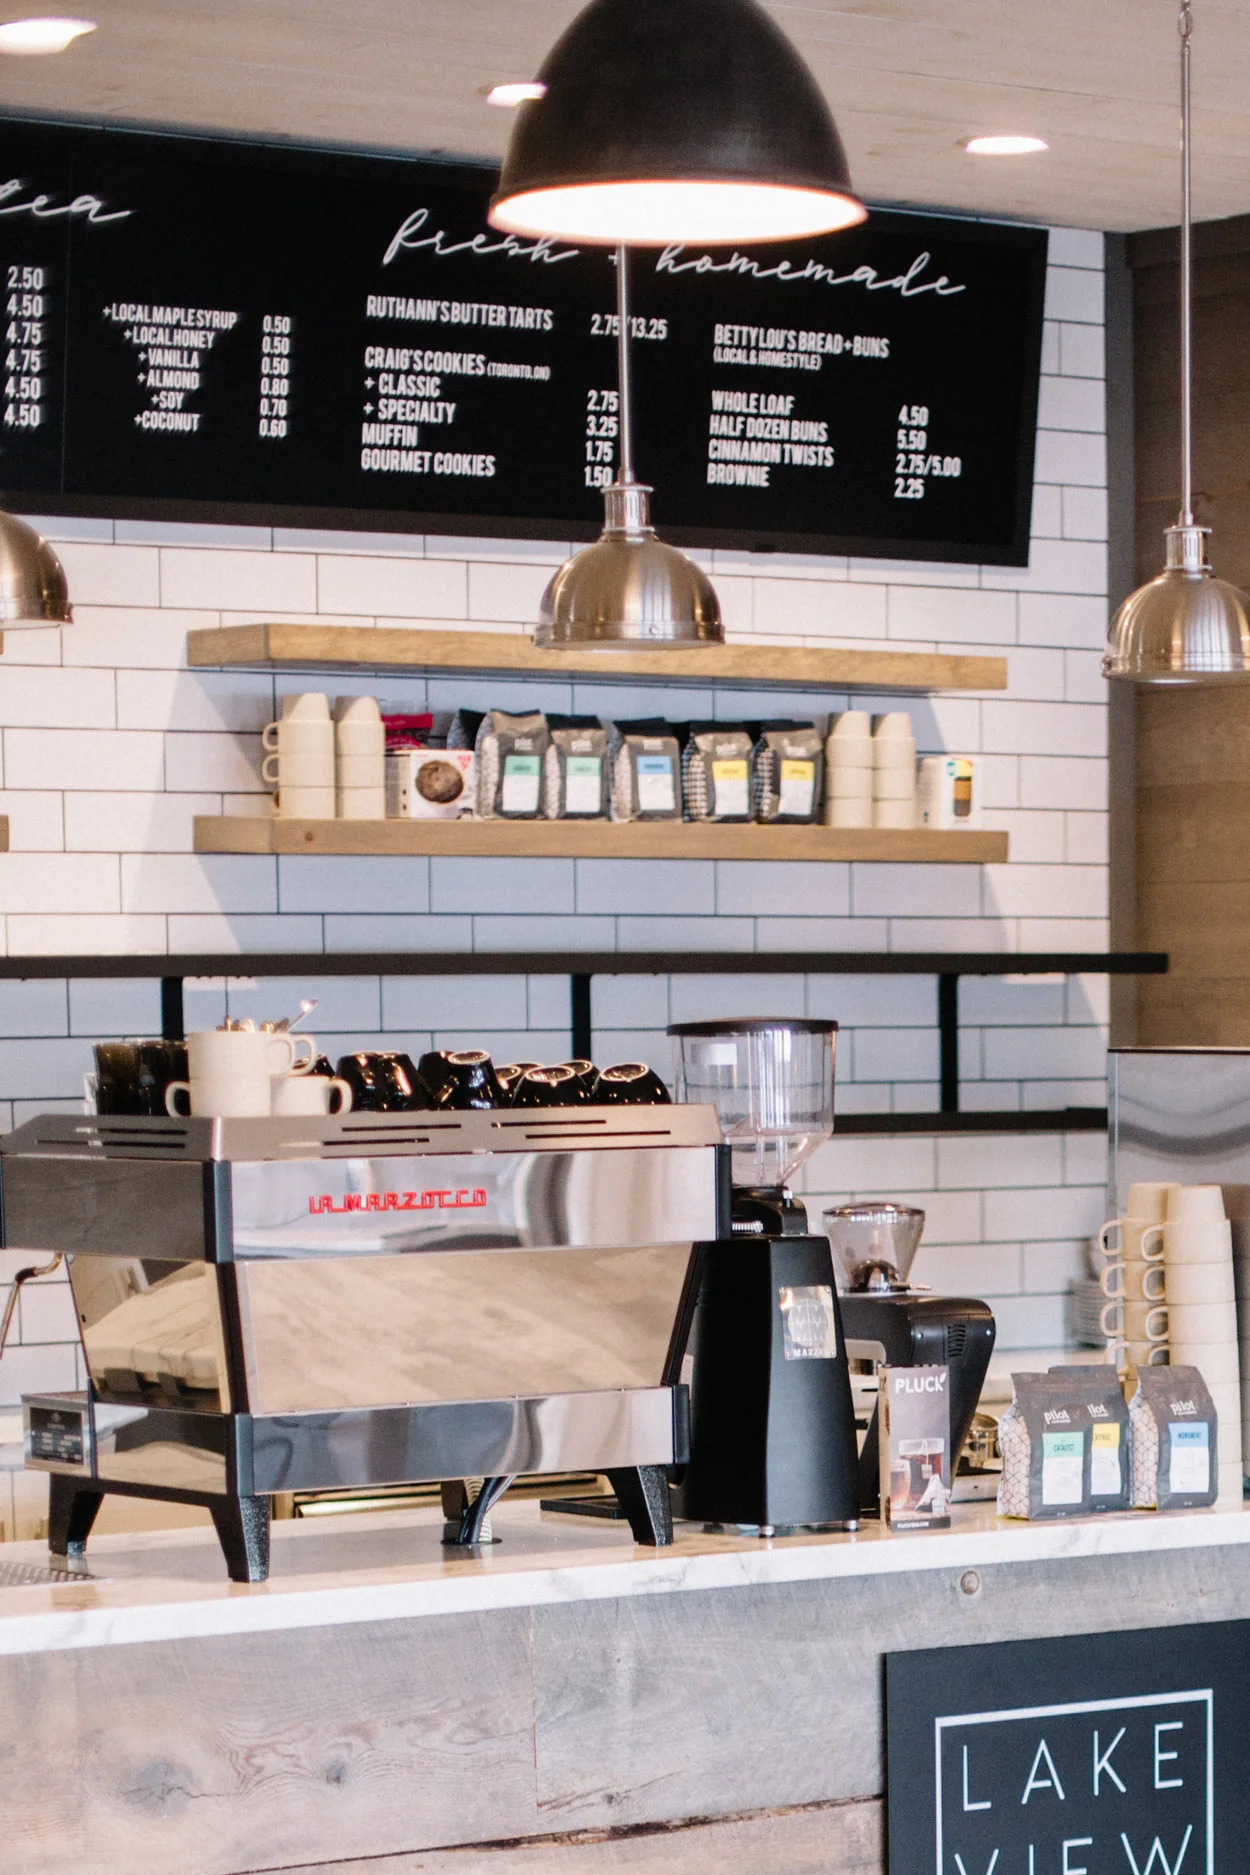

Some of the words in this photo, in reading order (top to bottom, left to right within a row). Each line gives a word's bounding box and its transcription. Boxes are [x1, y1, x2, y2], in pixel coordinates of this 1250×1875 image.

[7, 265, 43, 289] 2.50
[655, 241, 967, 297] homemade
[6, 293, 43, 317] 4.50
[366, 294, 450, 322] RUTHANN'S
[450, 301, 507, 327] BUTTER
[508, 306, 554, 331] TARTS
[590, 313, 669, 340] 2.7513.25
[6, 321, 42, 345] 4.75
[152, 305, 196, 326] MAPLE
[195, 308, 238, 329] SYRUP
[262, 315, 291, 334] 0.50
[173, 328, 216, 348] HONEY
[262, 336, 290, 354] 0.50
[713, 323, 759, 347] BETTY
[759, 328, 798, 350] LOU'S
[5, 349, 41, 373] 4.75
[261, 356, 290, 375] 0.50
[364, 346, 424, 371] CRAIG'S
[424, 350, 486, 376] COOKIES
[713, 346, 750, 363] (LOCAL
[758, 350, 822, 371] HOMESTYLE)
[4, 376, 41, 400] 4.50
[260, 377, 289, 396] 0.80
[378, 372, 441, 398] CLASSIC
[586, 389, 619, 412] 2.75
[4, 403, 41, 427] 4.50
[259, 398, 287, 417] 0.70
[378, 398, 457, 424] SPECIALTY
[586, 414, 618, 437] 3.25
[711, 390, 759, 414] WHOLE
[759, 394, 795, 416] LOAF
[898, 404, 929, 427] 4.50
[259, 419, 287, 438] 0.60
[709, 414, 745, 437] HALF
[746, 417, 790, 440] DOZEN
[791, 420, 829, 443] BUNS
[897, 429, 927, 451] 5.50
[362, 422, 418, 447] MUFFIN
[585, 440, 614, 463] 1.75
[361, 448, 433, 474] GOURMET
[433, 452, 497, 477] COOKIES
[584, 466, 613, 488] 1.50
[708, 438, 781, 464] CINNAMON
[783, 443, 835, 468] TWISTS
[895, 453, 962, 478] 2.75/5.00
[707, 462, 770, 487] BROWNIE
[893, 477, 925, 499] 2.25
[895, 1372, 947, 1394] PLUCK
[963, 1721, 1184, 1812] LAKE
